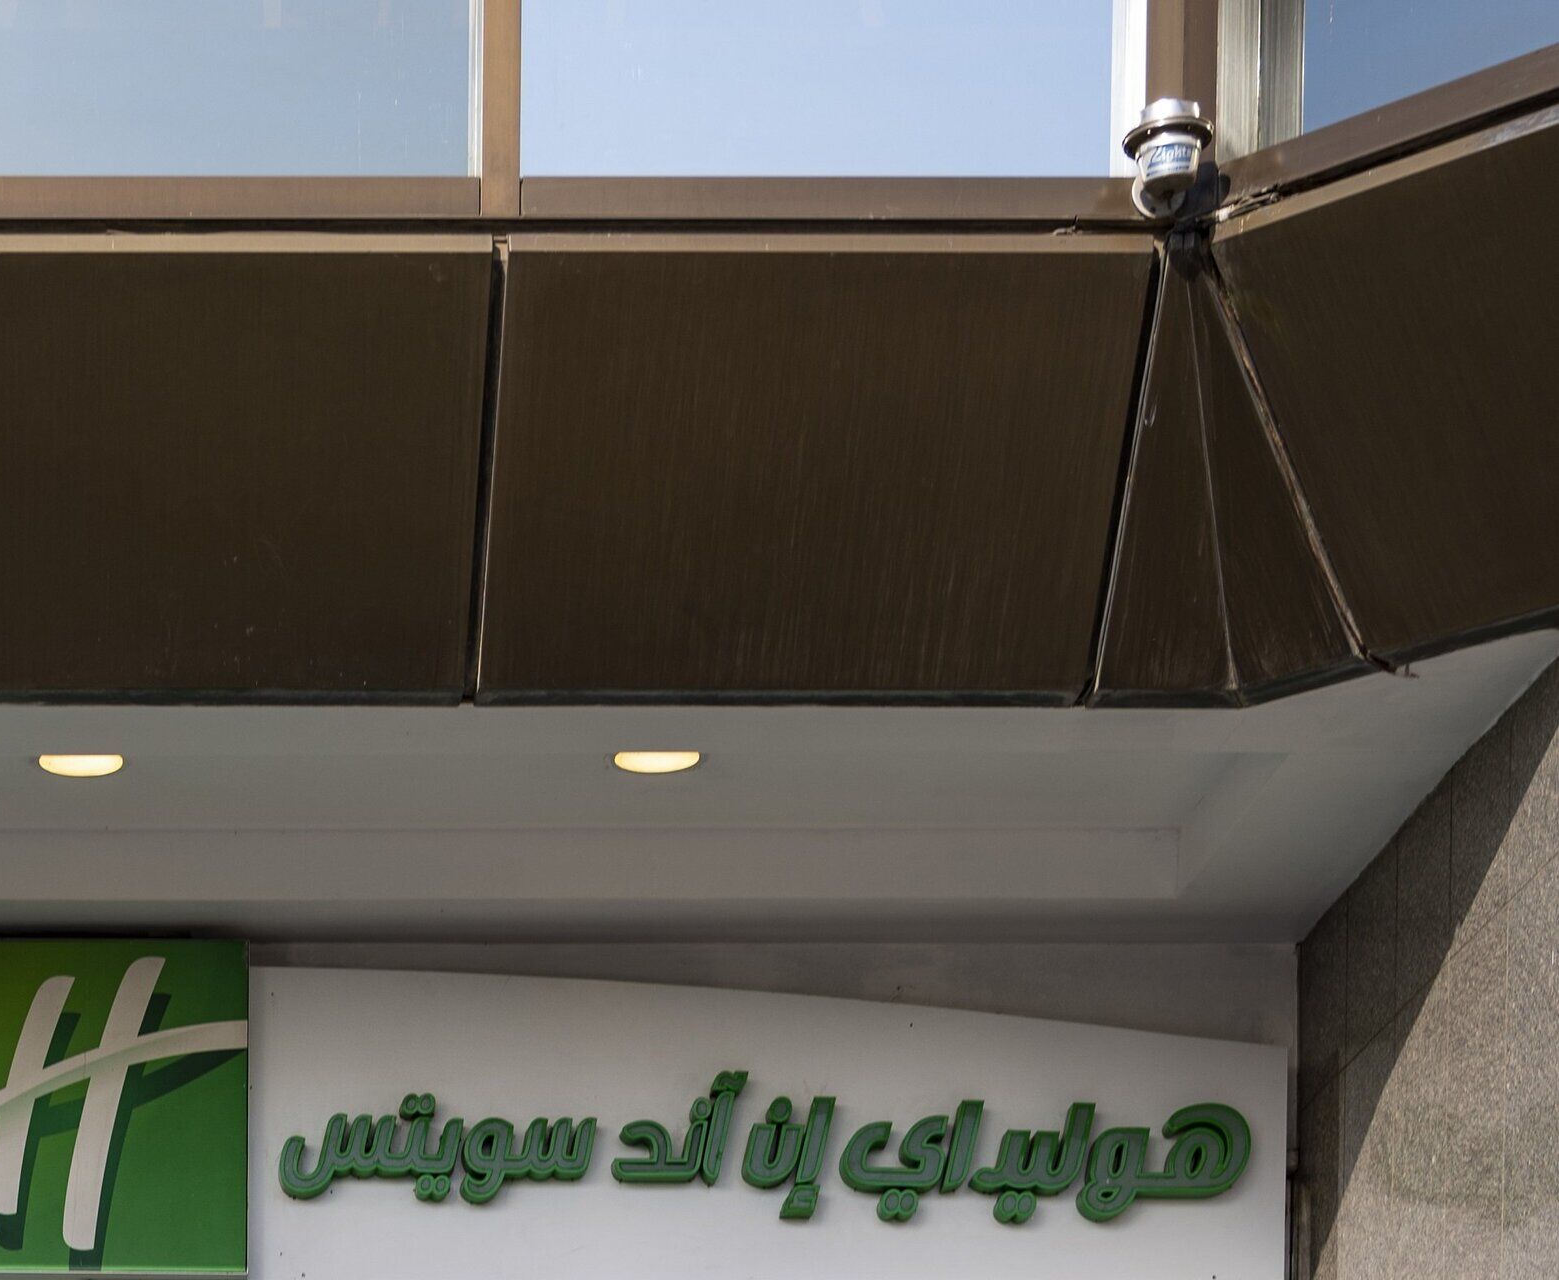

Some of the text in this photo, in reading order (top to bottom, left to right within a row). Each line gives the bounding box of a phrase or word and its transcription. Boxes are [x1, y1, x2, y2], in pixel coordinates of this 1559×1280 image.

[279, 1093, 597, 1205] سويتس
[742, 1095, 836, 1220] إن
[839, 1101, 1252, 1224] هوليداي
